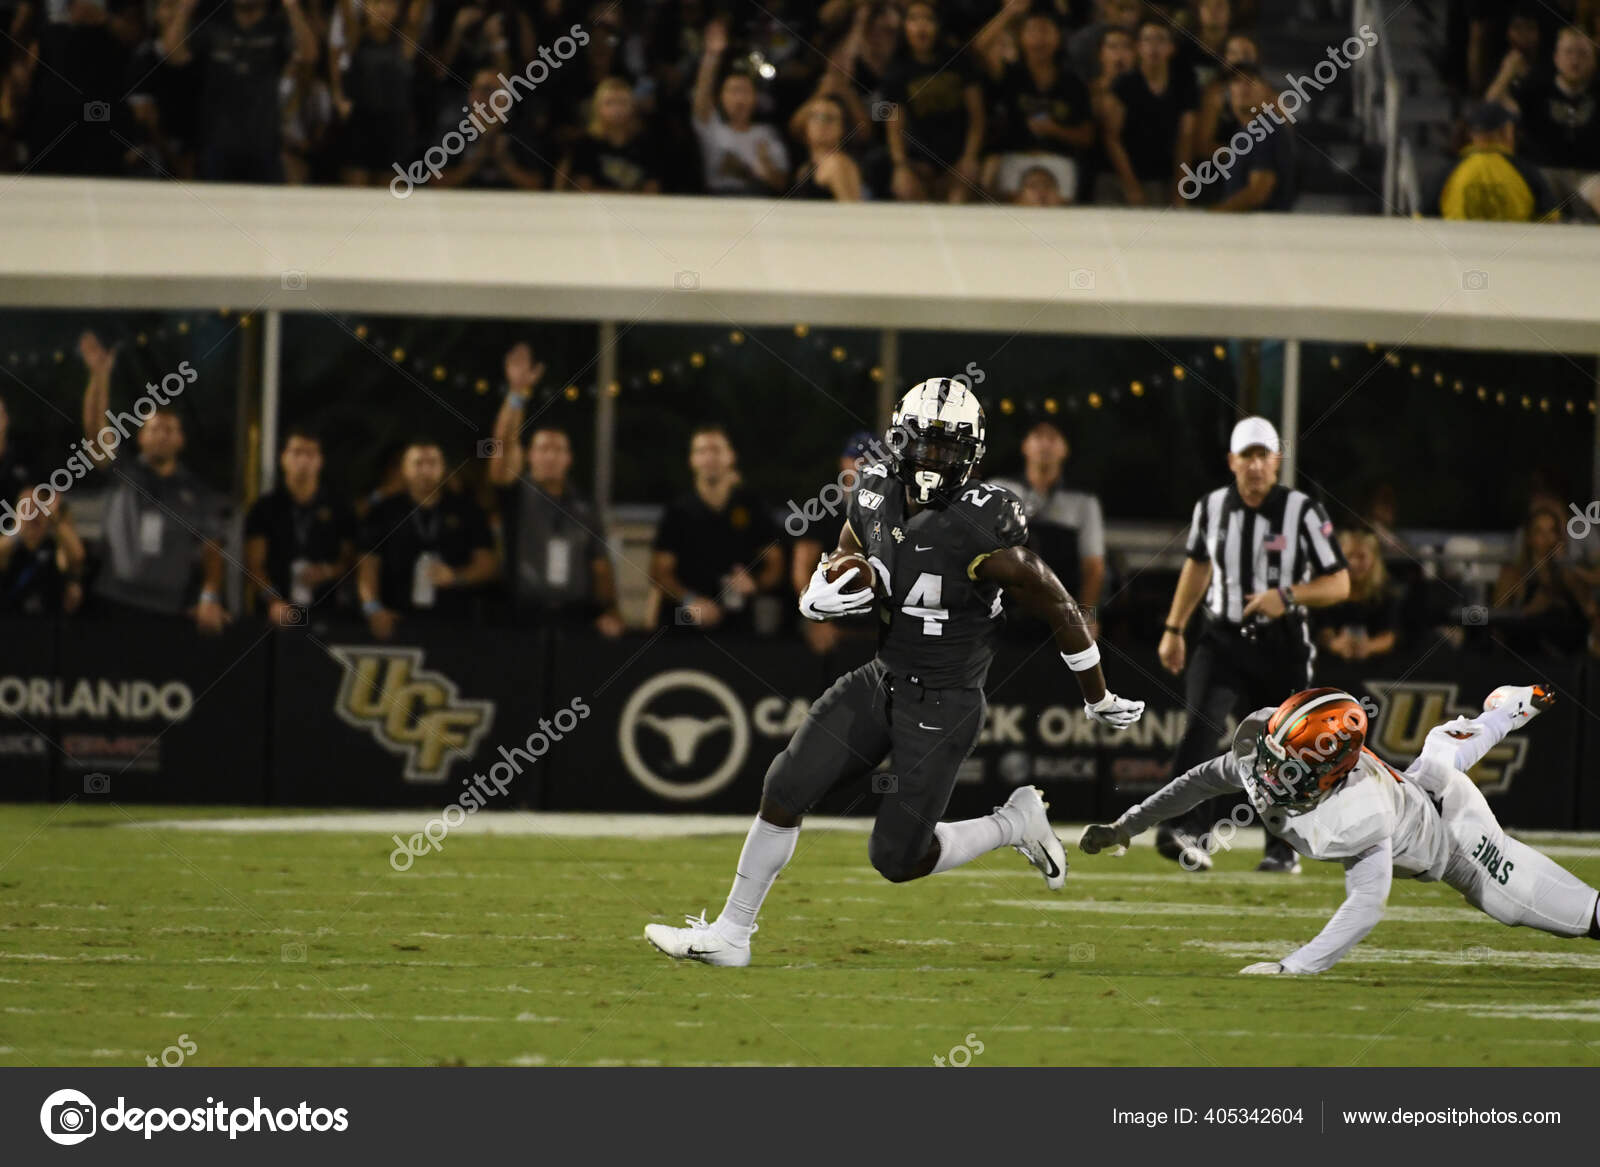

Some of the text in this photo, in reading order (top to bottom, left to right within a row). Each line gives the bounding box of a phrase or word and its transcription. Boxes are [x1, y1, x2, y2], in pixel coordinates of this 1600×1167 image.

[0, 676, 193, 720] ORLANDO
[332, 646, 494, 778] UCF
[1472, 835, 1514, 885] STRIKE
